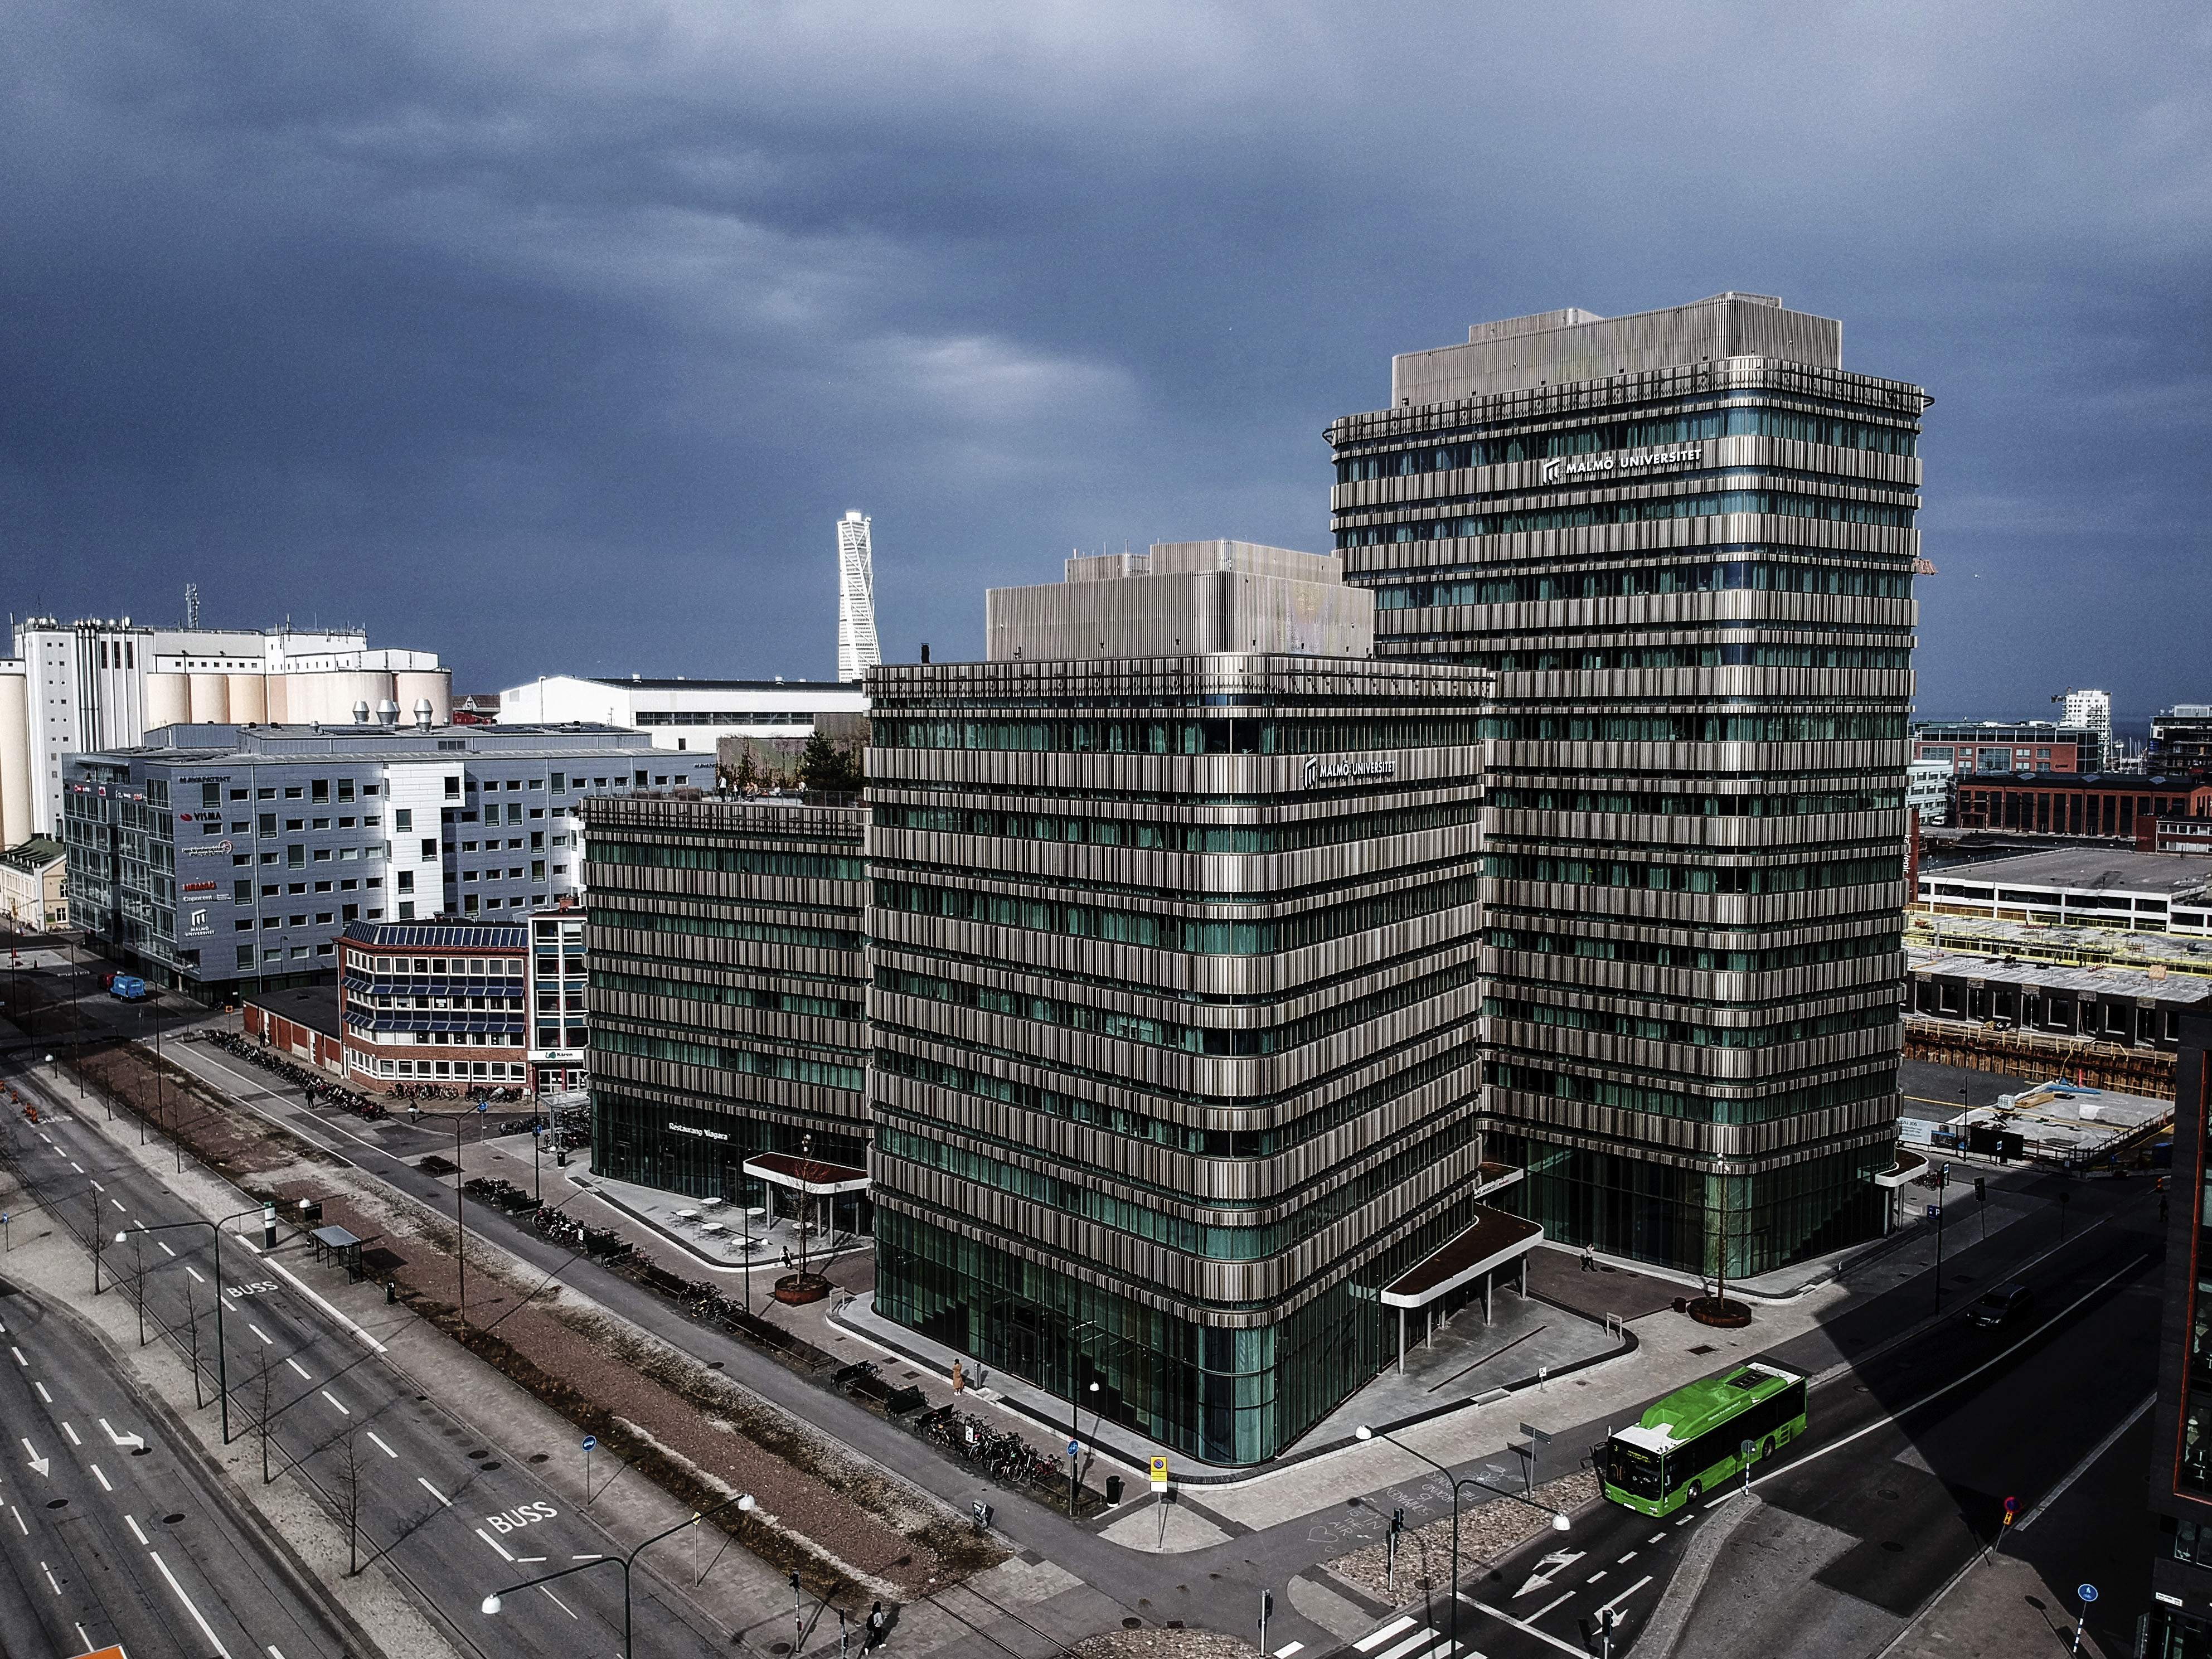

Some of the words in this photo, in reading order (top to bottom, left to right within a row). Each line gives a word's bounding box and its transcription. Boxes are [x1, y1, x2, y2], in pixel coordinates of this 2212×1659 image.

[1566, 457, 1614, 474] MALMÖ
[1620, 449, 1702, 468] UNIVERSITET
[1320, 760, 1349, 778] MALMÖ
[1352, 760, 1395, 775] UNIVERSITET
[194, 812, 222, 821] VISMA
[668, 1122, 703, 1137] Restaurang
[226, 1279, 279, 1298] BUSS
[486, 1500, 559, 1534] BUSS
[1328, 1521, 1353, 1536] AIR
